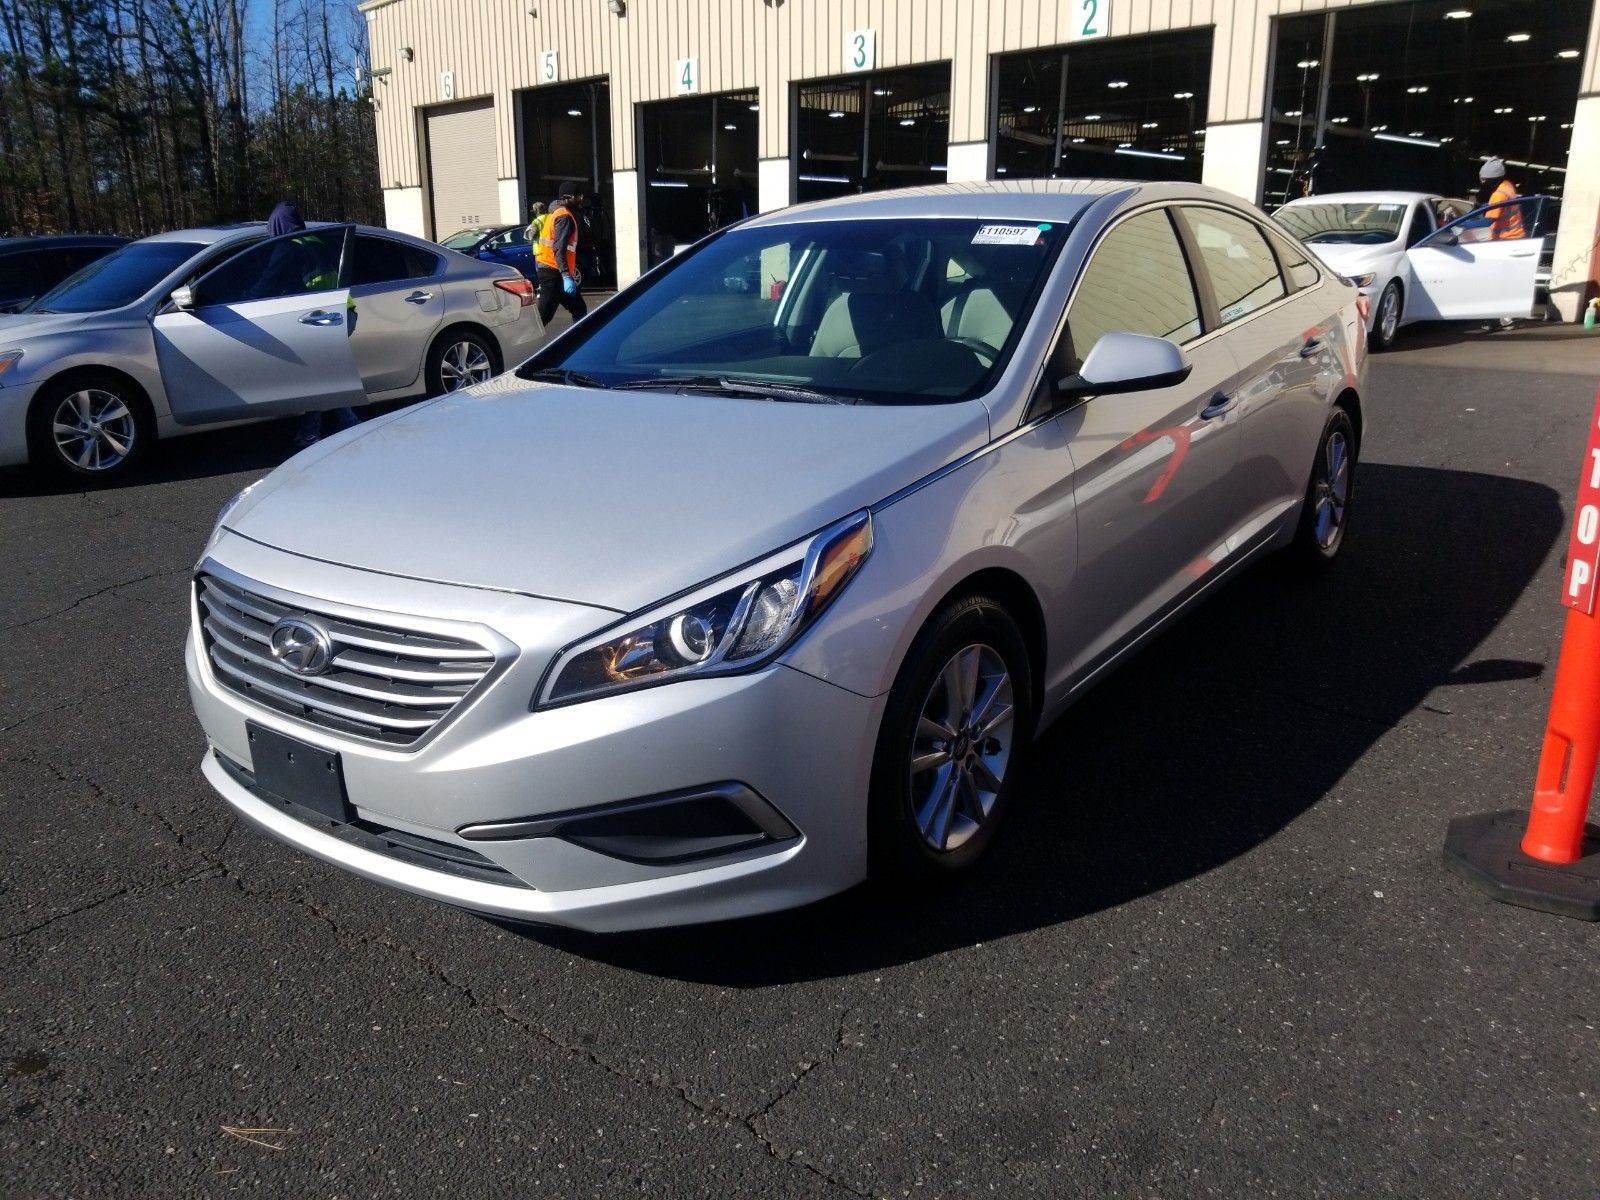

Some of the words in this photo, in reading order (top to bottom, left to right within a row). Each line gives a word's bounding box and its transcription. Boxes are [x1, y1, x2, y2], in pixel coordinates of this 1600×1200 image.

[1082, 0, 1098, 35] 2
[853, 34, 866, 67] 3
[545, 53, 555, 79] 5
[681, 62, 692, 90] 4
[444, 75, 452, 98] 6
[977, 225, 1028, 236] 6110597
[1568, 416, 1600, 598] TOP
